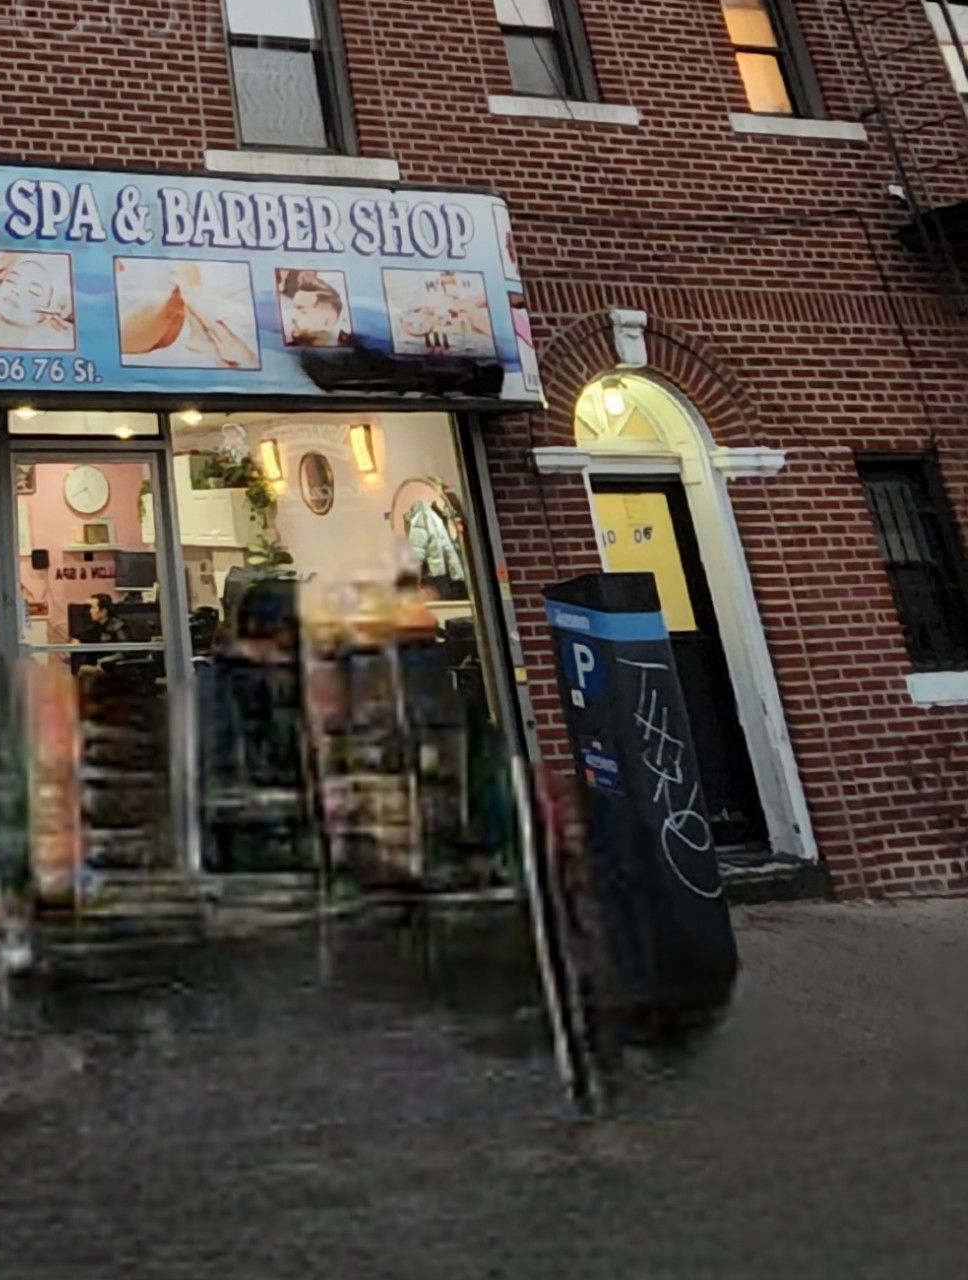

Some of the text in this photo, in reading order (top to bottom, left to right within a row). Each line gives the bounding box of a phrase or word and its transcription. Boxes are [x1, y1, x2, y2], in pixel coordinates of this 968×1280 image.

[4, 177, 107, 242] SPA
[112, 183, 152, 245] &
[158, 187, 345, 255] BARBER
[349, 199, 475, 258] SHOP
[33, 357, 65, 383] 76
[73, 357, 103, 384] St.
[573, 643, 595, 689] P
